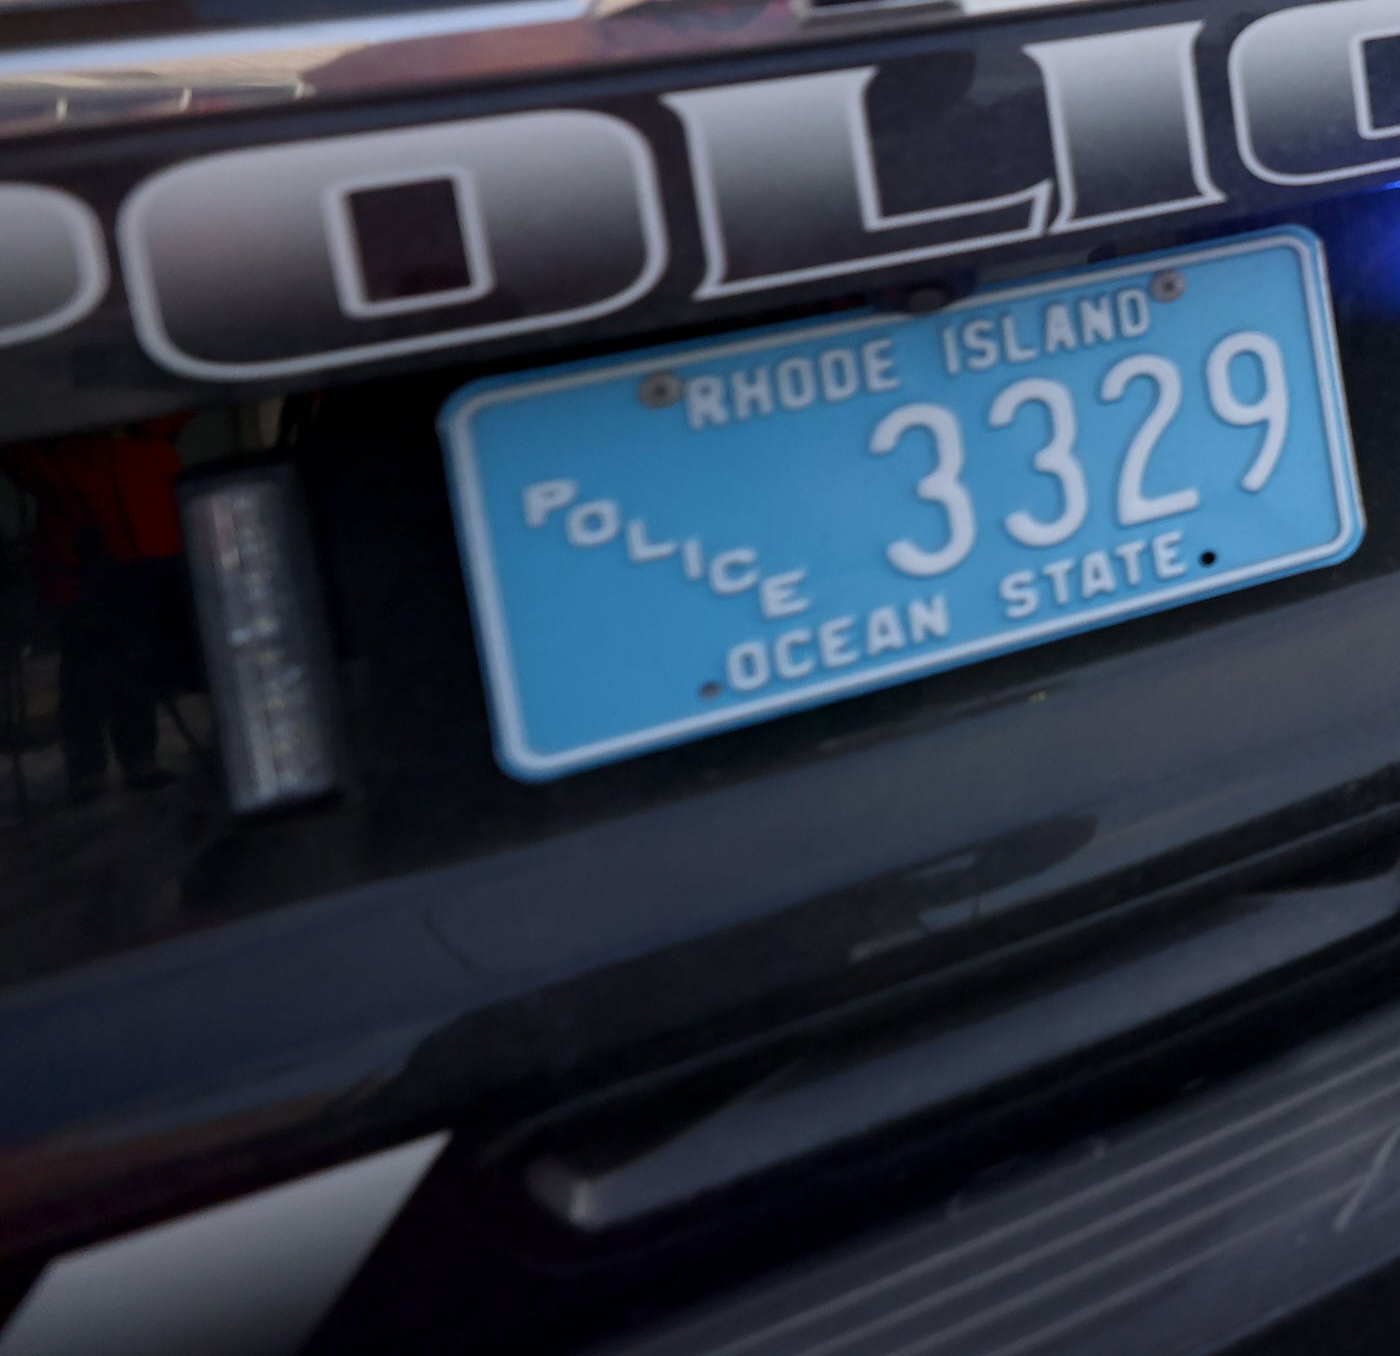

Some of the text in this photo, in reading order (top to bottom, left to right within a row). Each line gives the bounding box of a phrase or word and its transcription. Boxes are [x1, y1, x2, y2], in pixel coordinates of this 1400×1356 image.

[682, 286, 1152, 430] RHODE ISLAND
[867, 331, 1290, 578] 3329
[523, 478, 810, 620] POLICE
[725, 530, 1187, 693] OCEAN STATE
